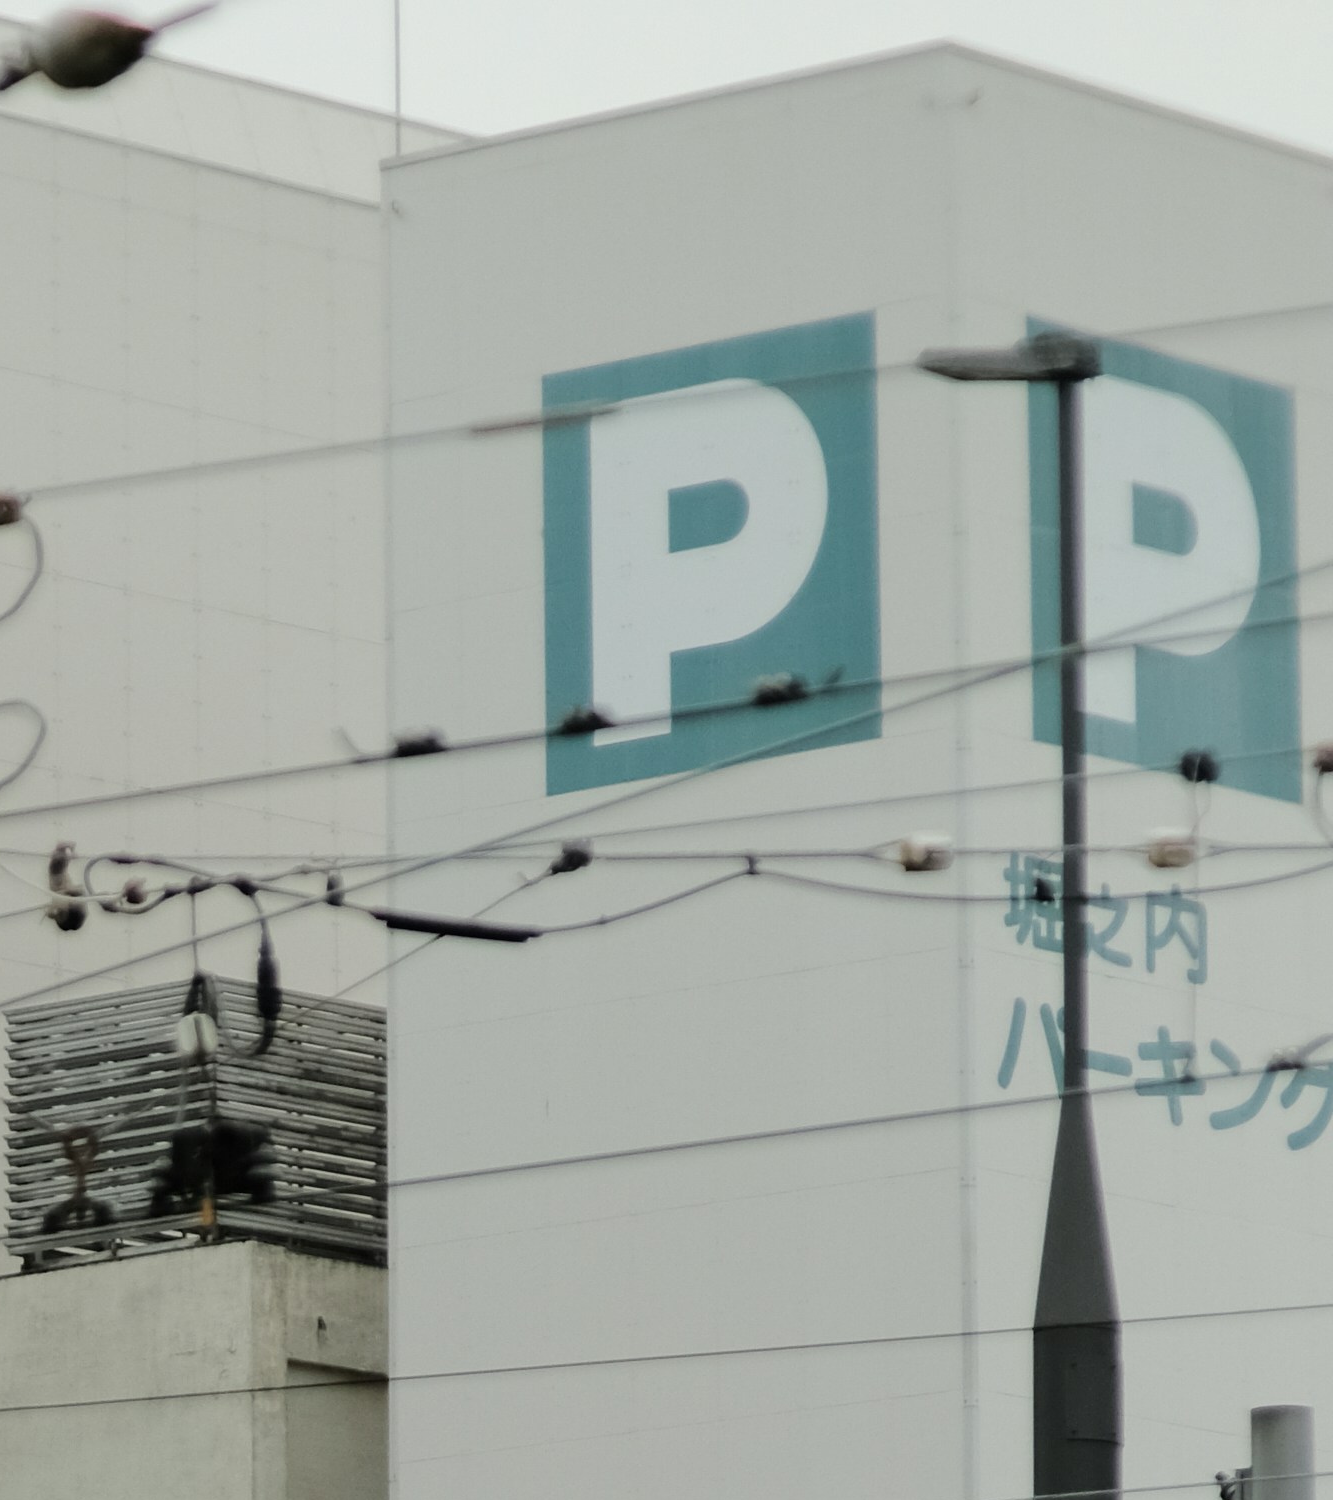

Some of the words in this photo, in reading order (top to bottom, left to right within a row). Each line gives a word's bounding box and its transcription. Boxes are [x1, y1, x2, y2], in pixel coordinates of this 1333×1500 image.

[589, 378, 829, 747] P
[1079, 374, 1261, 725] P
[1003, 851, 1208, 985] 堀之内
